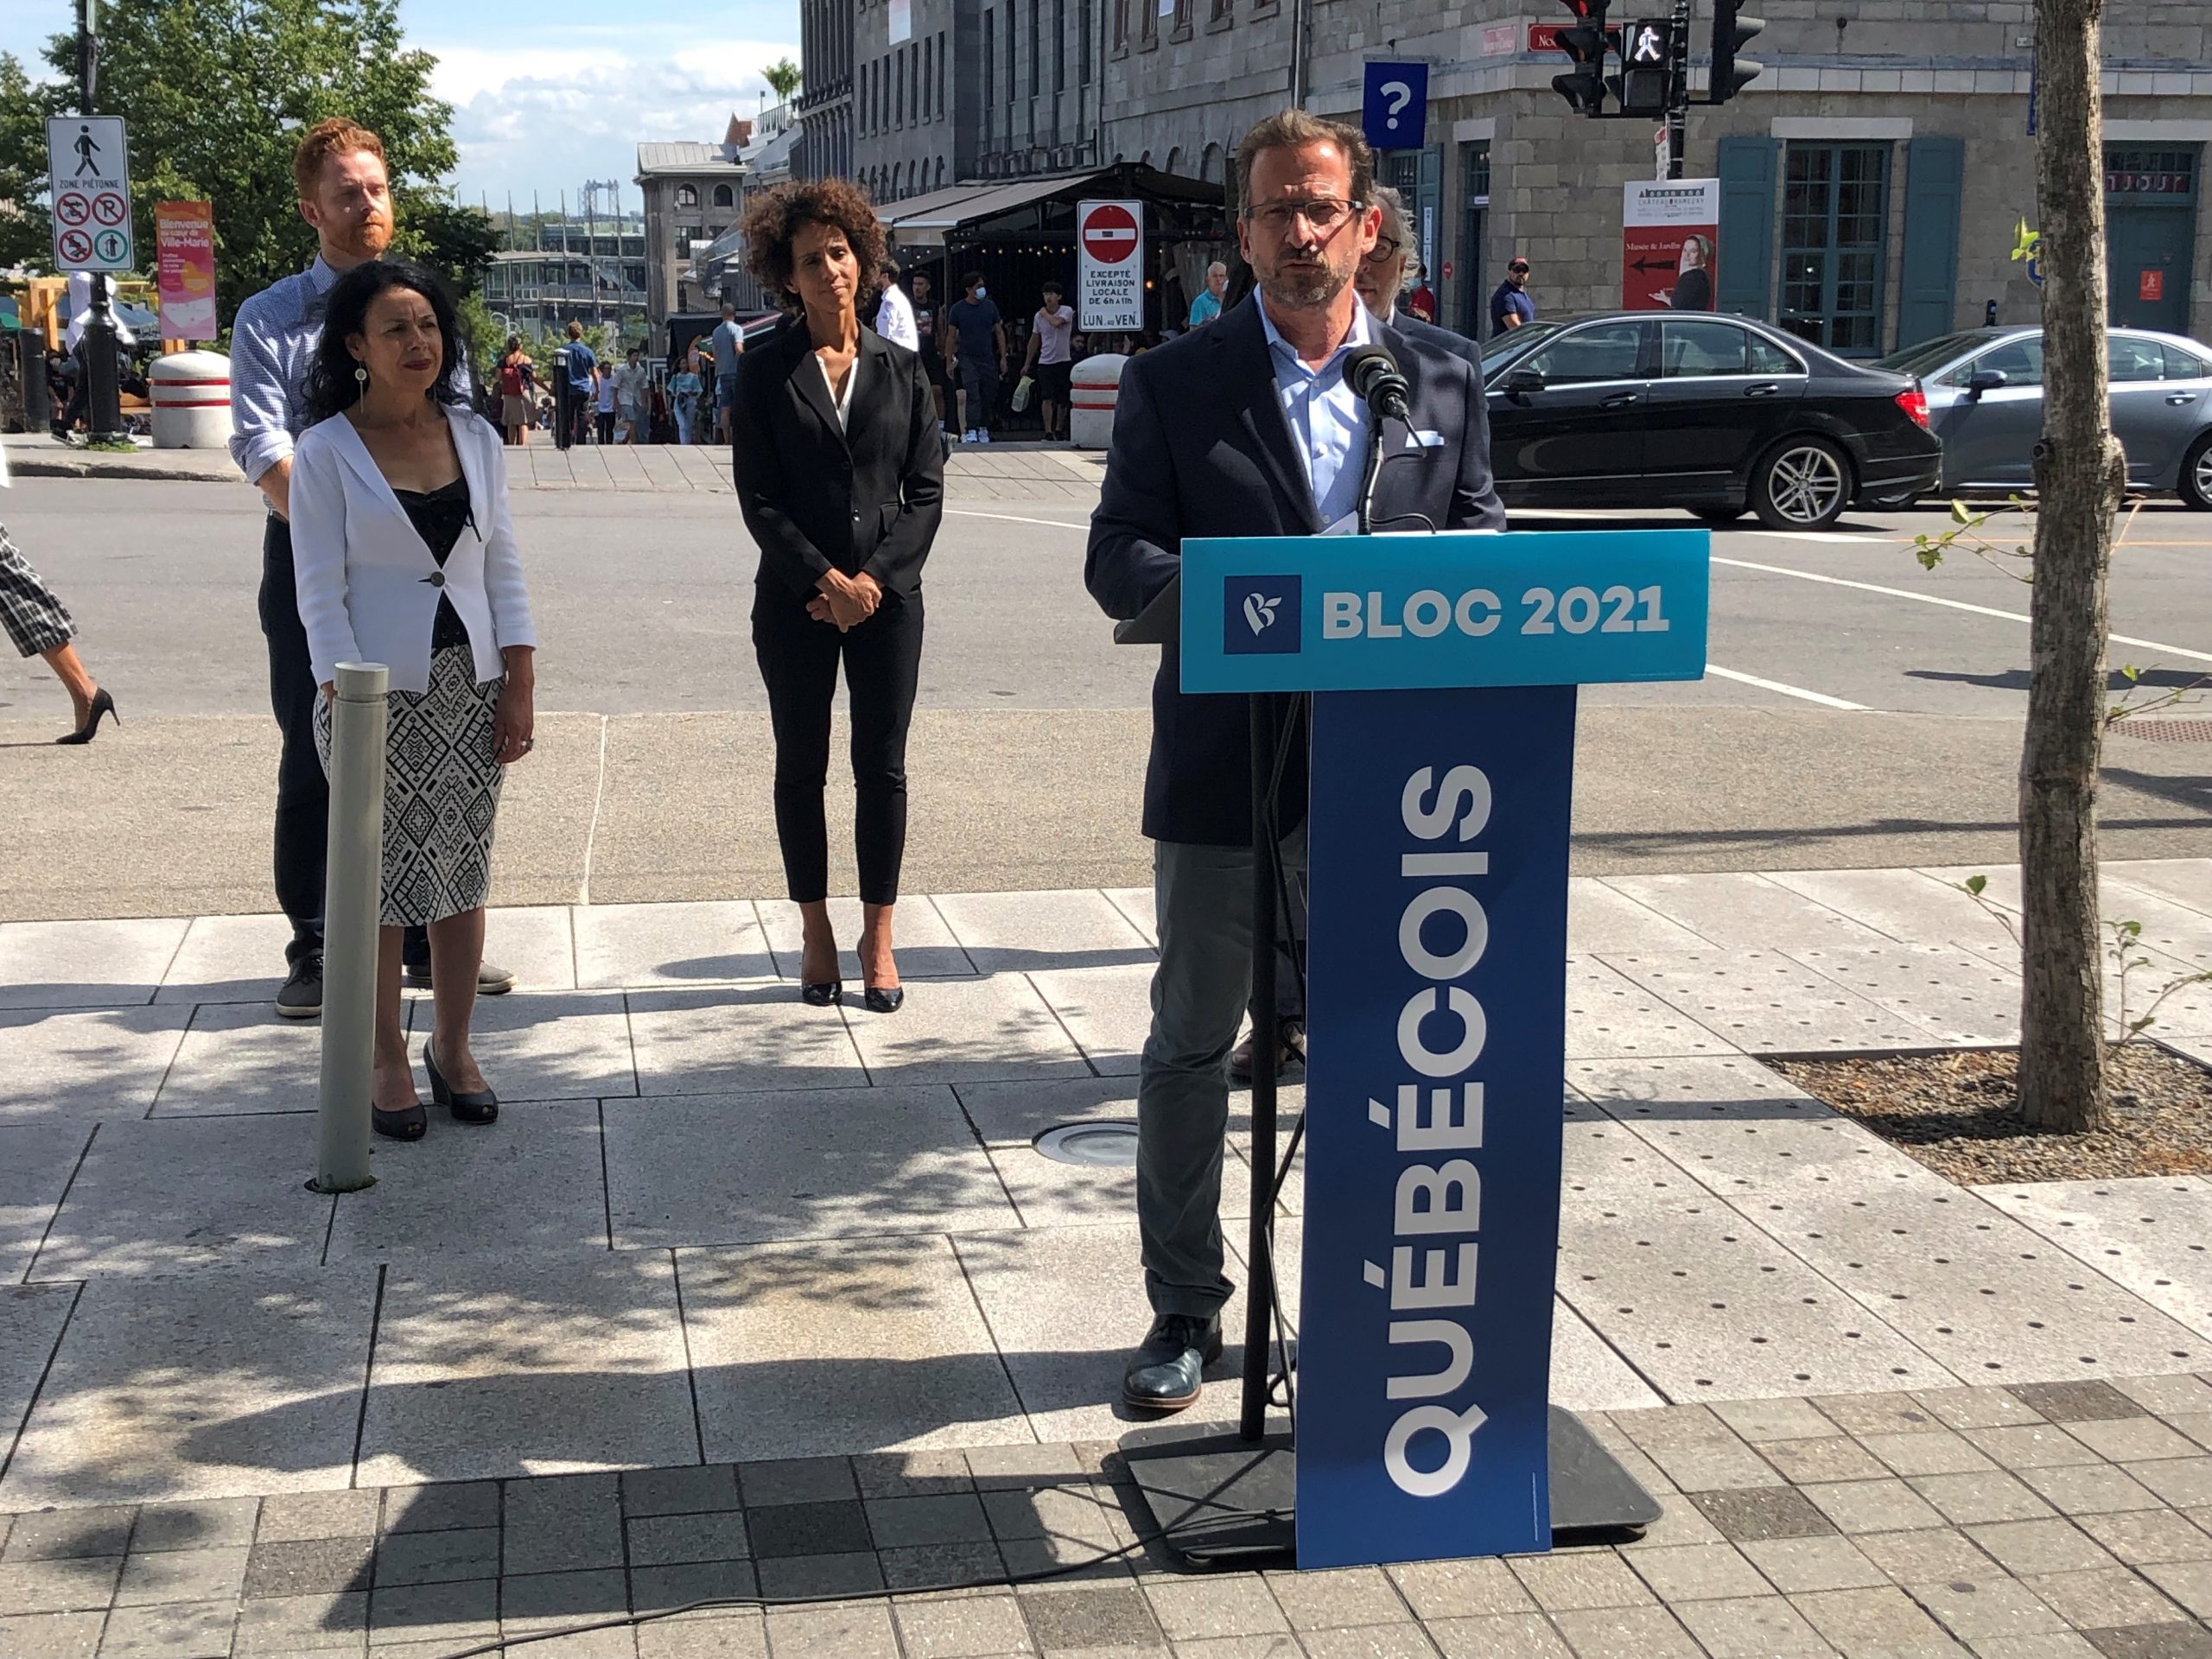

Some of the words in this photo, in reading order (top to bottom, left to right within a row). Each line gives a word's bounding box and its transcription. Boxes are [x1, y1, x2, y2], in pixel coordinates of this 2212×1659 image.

[60, 179, 79, 189] ZONE
[82, 177, 119, 189] PIÉTONNE
[159, 219, 209, 229] Bienvenue
[161, 236, 209, 248] Ville-Marie
[1626, 242, 1649, 251] Musée
[1659, 241, 1681, 250] Jardin
[1090, 268, 1131, 278] EXCEPTÉ
[1086, 279, 1135, 288] LIVRAISON
[1103, 296, 1115, 305] 6h
[1122, 296, 1133, 305] 11h
[1115, 314, 1140, 327] VEN.
[1323, 589, 1502, 639] BLOC
[1521, 585, 1669, 635] 2021
[1363, 765, 1493, 1497] QUÉBÉCOIS
